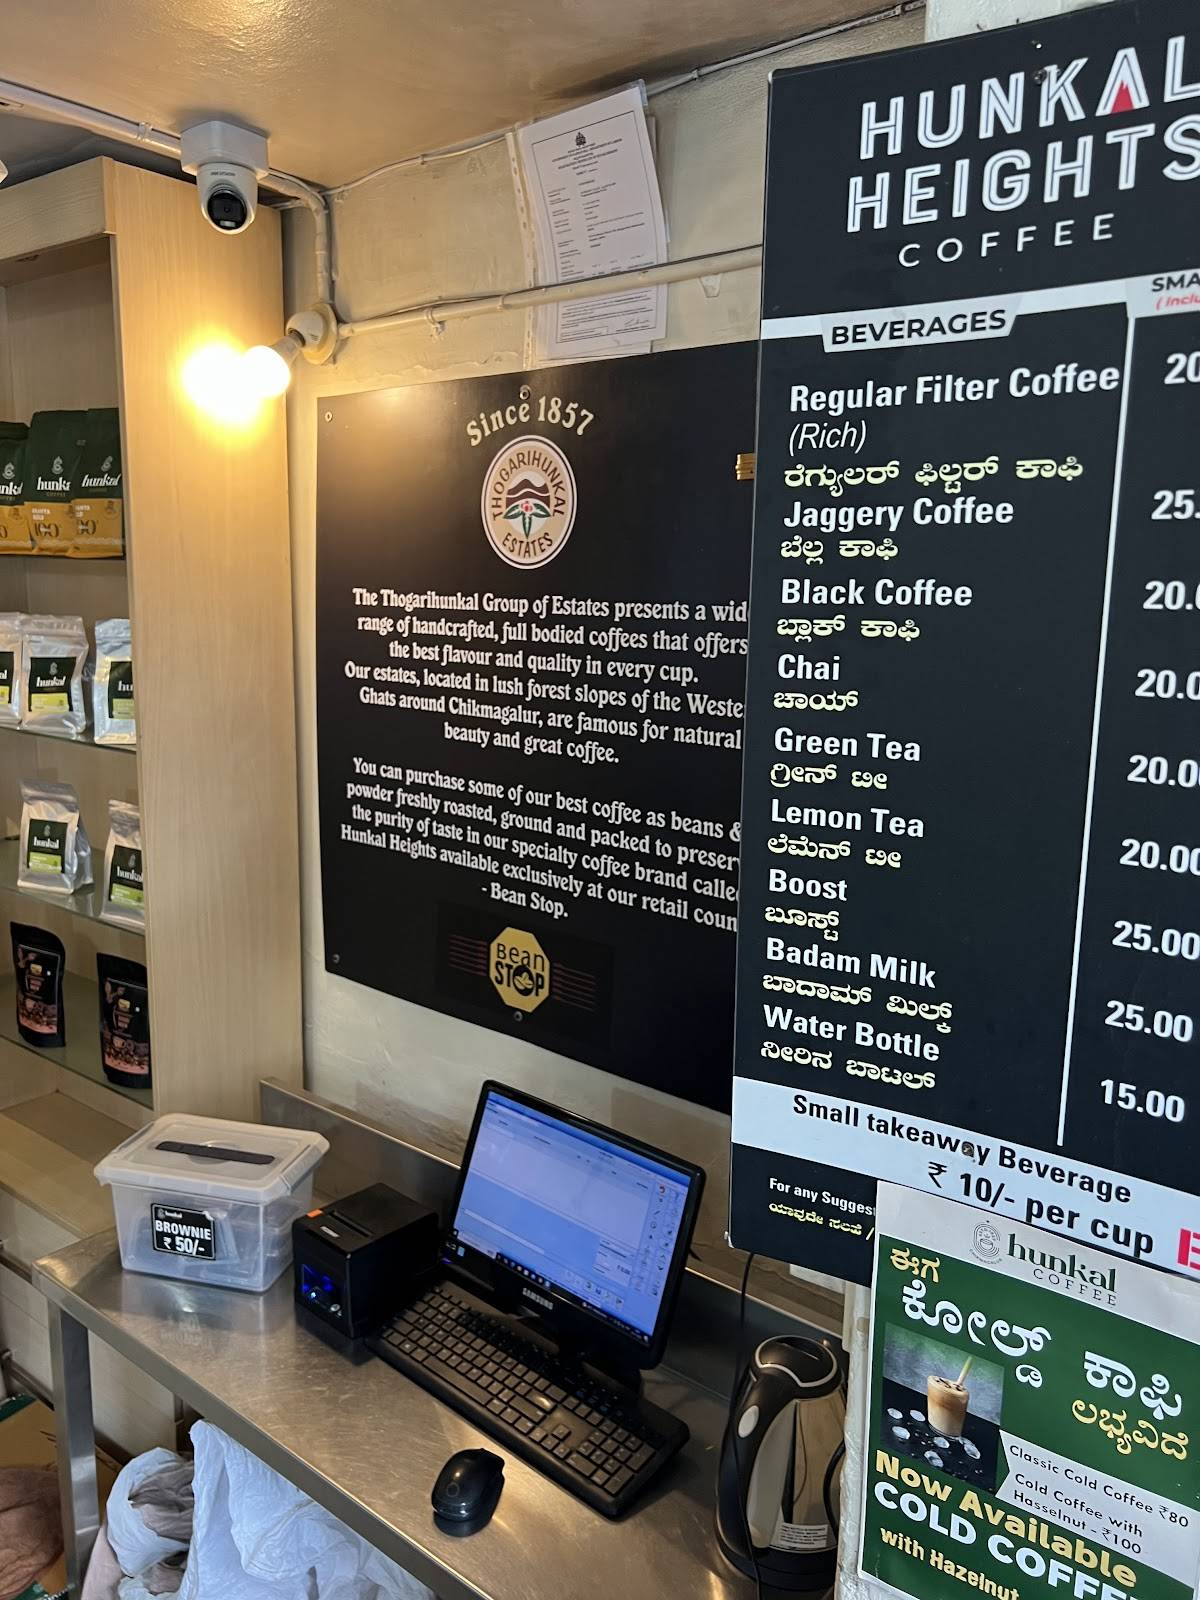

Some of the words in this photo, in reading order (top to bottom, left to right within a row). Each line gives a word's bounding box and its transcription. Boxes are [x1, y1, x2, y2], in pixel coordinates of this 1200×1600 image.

[859, 35, 1200, 160] HUNKAL
[846, 113, 1200, 233] HEIGHTS
[899, 213, 1115, 267] COFFEE
[831, 309, 1007, 346] BEVERAGES
[790, 380, 907, 417] Regular
[915, 374, 1000, 405] Filter
[1009, 362, 1120, 398] Coffee
[466, 401, 530, 446] Since
[537, 396, 594, 435] 1857
[789, 420, 867, 456] (Rich)
[491, 450, 567, 521] THOGARIHUNKAL
[1015, 456, 1084, 481] ಕಾಫಿ
[783, 502, 905, 533] Jaggery
[913, 496, 1014, 525] Coffee
[502, 532, 553, 558] ESTATES
[780, 535, 824, 565] ಬೆಲ್ಲ
[839, 537, 899, 561] ಕಾಫಿ
[352, 587, 378, 606] The
[380, 588, 479, 612] Thogarihunkal
[482, 593, 529, 617] Group
[532, 595, 549, 619] of
[551, 595, 609, 617] Estates
[614, 601, 690, 622] presents
[694, 604, 707, 621] a
[711, 600, 749, 622] wid
[781, 578, 865, 605] Black
[874, 578, 973, 606] Coffee
[1142, 580, 1200, 610] 20.
[357, 617, 394, 636] range
[396, 616, 411, 637] of
[412, 616, 499, 642] handcrafted,
[500, 621, 527, 644] full
[531, 623, 585, 645] bodied
[588, 627, 648, 652] coffees
[652, 630, 689, 651] that
[693, 632, 749, 658] offers
[860, 618, 921, 642] ಕಾಫಿ
[389, 640, 410, 658] the
[412, 642, 440, 662] best
[441, 644, 493, 666] flavour
[495, 650, 524, 669] and
[527, 653, 582, 678] quality
[585, 655, 602, 675] in
[606, 660, 656, 684] every
[659, 665, 699, 687] cup.
[777, 654, 841, 681] Chai
[359, 686, 396, 707] Ghats
[398, 695, 446, 713] around
[448, 696, 544, 728] Chikmagalur,
[547, 711, 573, 729] are
[575, 711, 638, 737] famous
[640, 719, 669, 743] for
[673, 726, 742, 750] natural
[773, 690, 859, 712] ಚಾಯ್
[444, 721, 490, 748] beauty
[493, 731, 520, 749] and
[524, 735, 563, 756] great
[566, 740, 620, 765] coffee.
[774, 727, 858, 757] Green
[866, 732, 921, 762] Tea
[851, 770, 888, 790] ಟೀ
[1127, 754, 1200, 788] 20.0
[347, 782, 394, 802] powder
[394, 788, 441, 815] freshly
[443, 800, 498, 825] roasted,
[500, 810, 553, 834] ground
[556, 822, 586, 841] and
[590, 828, 650, 854] packed
[655, 839, 672, 858] to
[771, 798, 862, 831] Lemon
[870, 807, 925, 838] Tea
[340, 823, 387, 849] Hunkal
[389, 834, 438, 860] Heights
[439, 848, 500, 875] available
[502, 862, 584, 897] exclusively
[587, 883, 603, 899] at
[607, 887, 638, 907] our
[641, 895, 689, 920] retail
[865, 848, 902, 868] ಟೀ
[490, 882, 527, 907] Bean
[529, 891, 569, 919] Stop.
[769, 868, 848, 902] Boost
[496, 943, 544, 972] Bean
[1112, 920, 1200, 960] 25.00
[494, 960, 545, 997] STOP
[766, 937, 861, 974] Badam
[869, 953, 937, 989] Milk
[763, 1004, 847, 1042] Water
[855, 1022, 940, 1063] Bottle
[1104, 1000, 1194, 1044] 25.00
[845, 1057, 936, 1091] ಬಾಟಲ್
[1100, 1078, 1186, 1124] 15.00
[793, 1094, 860, 1129] Small
[866, 1113, 990, 1166] takeaway
[998, 1145, 1132, 1203] Beverage
[769, 1177, 791, 1193] For
[794, 1186, 818, 1203] any
[155, 1220, 212, 1241] BROWNIE
[959, 1172, 1016, 1208] 10/-
[1025, 1195, 1080, 1230] per
[1091, 1218, 1155, 1259] cup
[175, 1236, 205, 1256] 50/-
[1007, 1233, 1117, 1293] hunkal
[1033, 1268, 1117, 1306] COFFEE
[1082, 1350, 1183, 1421] ಕಾಫಿ
[1009, 1444, 1059, 1474] Classic
[1064, 1468, 1098, 1490] Cold
[1103, 1485, 1154, 1514] Coffee
[875, 1449, 954, 1503] Now
[959, 1491, 1138, 1589] Available
[1014, 1489, 1086, 1530] Hasselnut
[1015, 1473, 1048, 1495] Cold
[1053, 1490, 1103, 1520] Coffee
[1108, 1516, 1143, 1538] with
[873, 1480, 977, 1546] COLD
[987, 1534, 1139, 1600] COFFE
[880, 1526, 926, 1561] with
[929, 1548, 1021, 1600] Hazelnut
